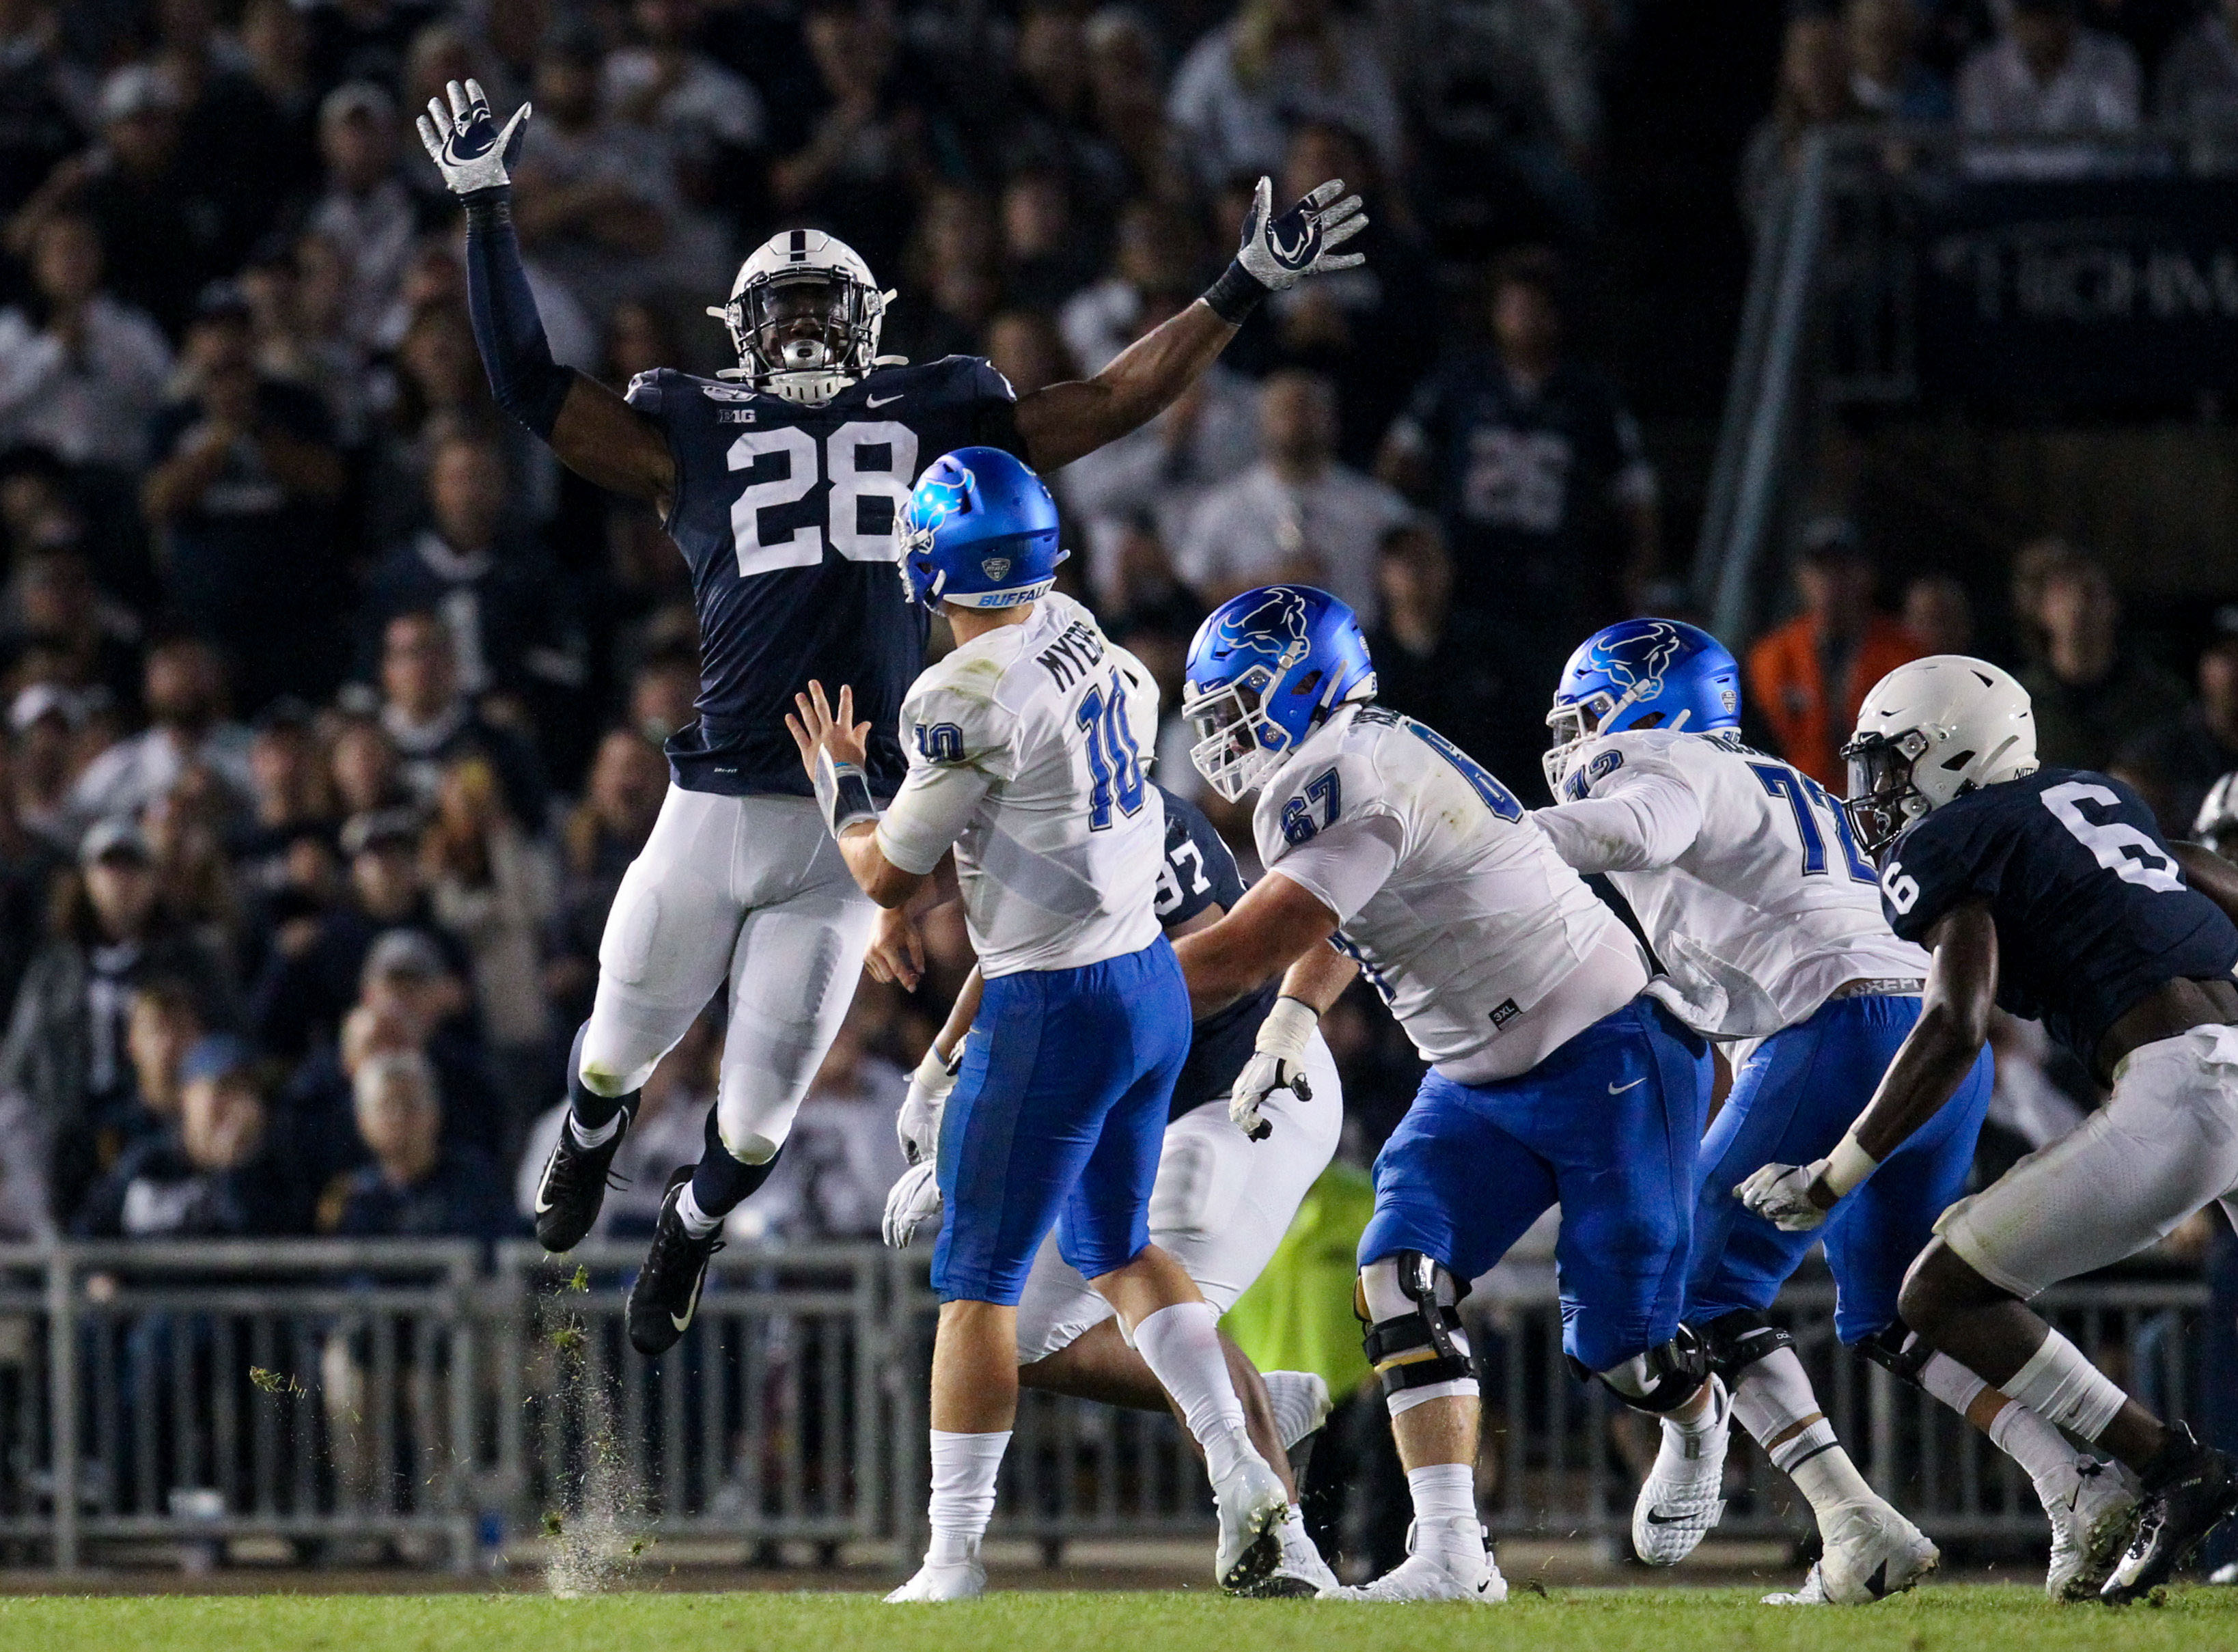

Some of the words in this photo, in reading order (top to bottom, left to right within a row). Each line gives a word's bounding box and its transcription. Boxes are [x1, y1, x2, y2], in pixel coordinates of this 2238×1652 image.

[727, 421, 918, 577] 28
[1036, 620, 1105, 693] MYERS
[915, 723, 965, 762] 10
[1076, 665, 1145, 833] 10
[1280, 767, 1342, 848] 67
[2040, 782, 2187, 893] 6
[1154, 839, 1212, 916] 97
[1882, 862, 1920, 915] 6
[1493, 1006, 1515, 1021] 3XL
